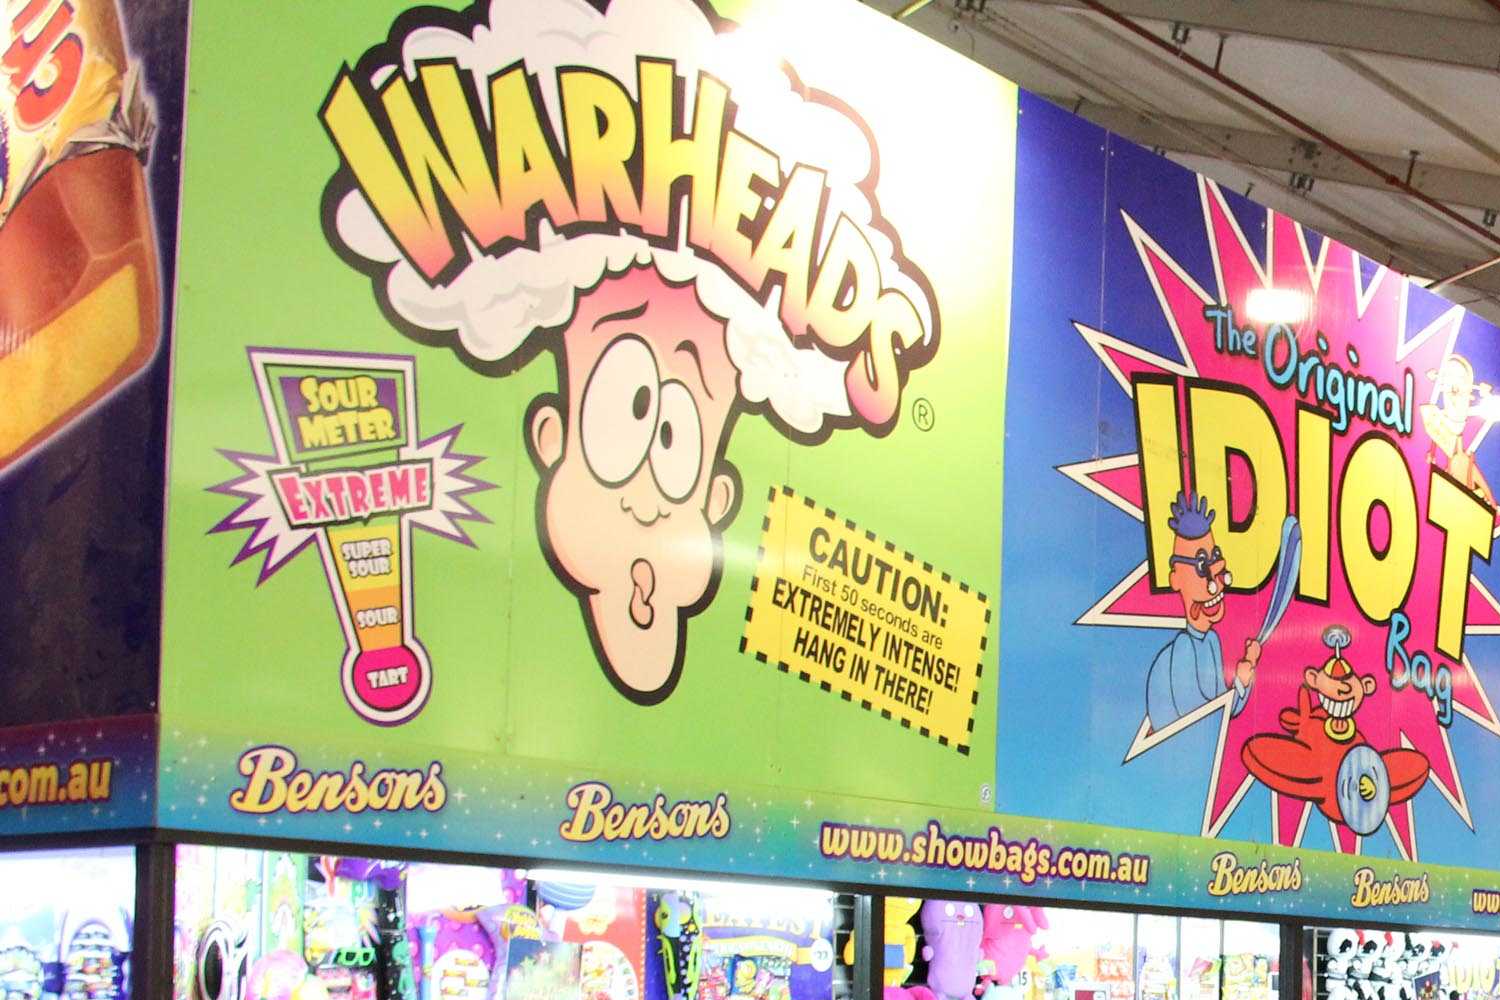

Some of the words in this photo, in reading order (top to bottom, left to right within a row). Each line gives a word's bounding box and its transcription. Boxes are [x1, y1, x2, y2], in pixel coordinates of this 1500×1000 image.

[319, 57, 926, 425] WARHEADS
[299, 375, 378, 413] SOUR
[1205, 307, 1258, 357] The
[1263, 322, 1414, 435] Original
[298, 407, 396, 449] METER
[279, 466, 428, 523] EXTREME
[1133, 374, 1496, 663] IDIOT
[341, 538, 393, 561] SUPER
[349, 556, 392, 578] SOUR
[808, 527, 949, 627] CAUTION:
[356, 606, 399, 629] SOUR
[772, 577, 881, 652] EXTREMELY
[883, 631, 961, 693] INTENSE!
[802, 565, 837, 596] First
[840, 586, 858, 607] 50
[860, 599, 918, 638] seconds
[921, 631, 944, 650] are
[366, 666, 409, 689] TART
[793, 627, 847, 674] HANG
[849, 654, 870, 685] IN
[873, 665, 933, 715] THERE!
[1385, 609, 1454, 727] Bag
[230, 745, 447, 814] Bensons
[560, 781, 730, 843] Bensons
[821, 824, 1149, 886] www.showbags.com.au
[1207, 852, 1302, 897] Bensons
[1351, 868, 1430, 909] Bensons
